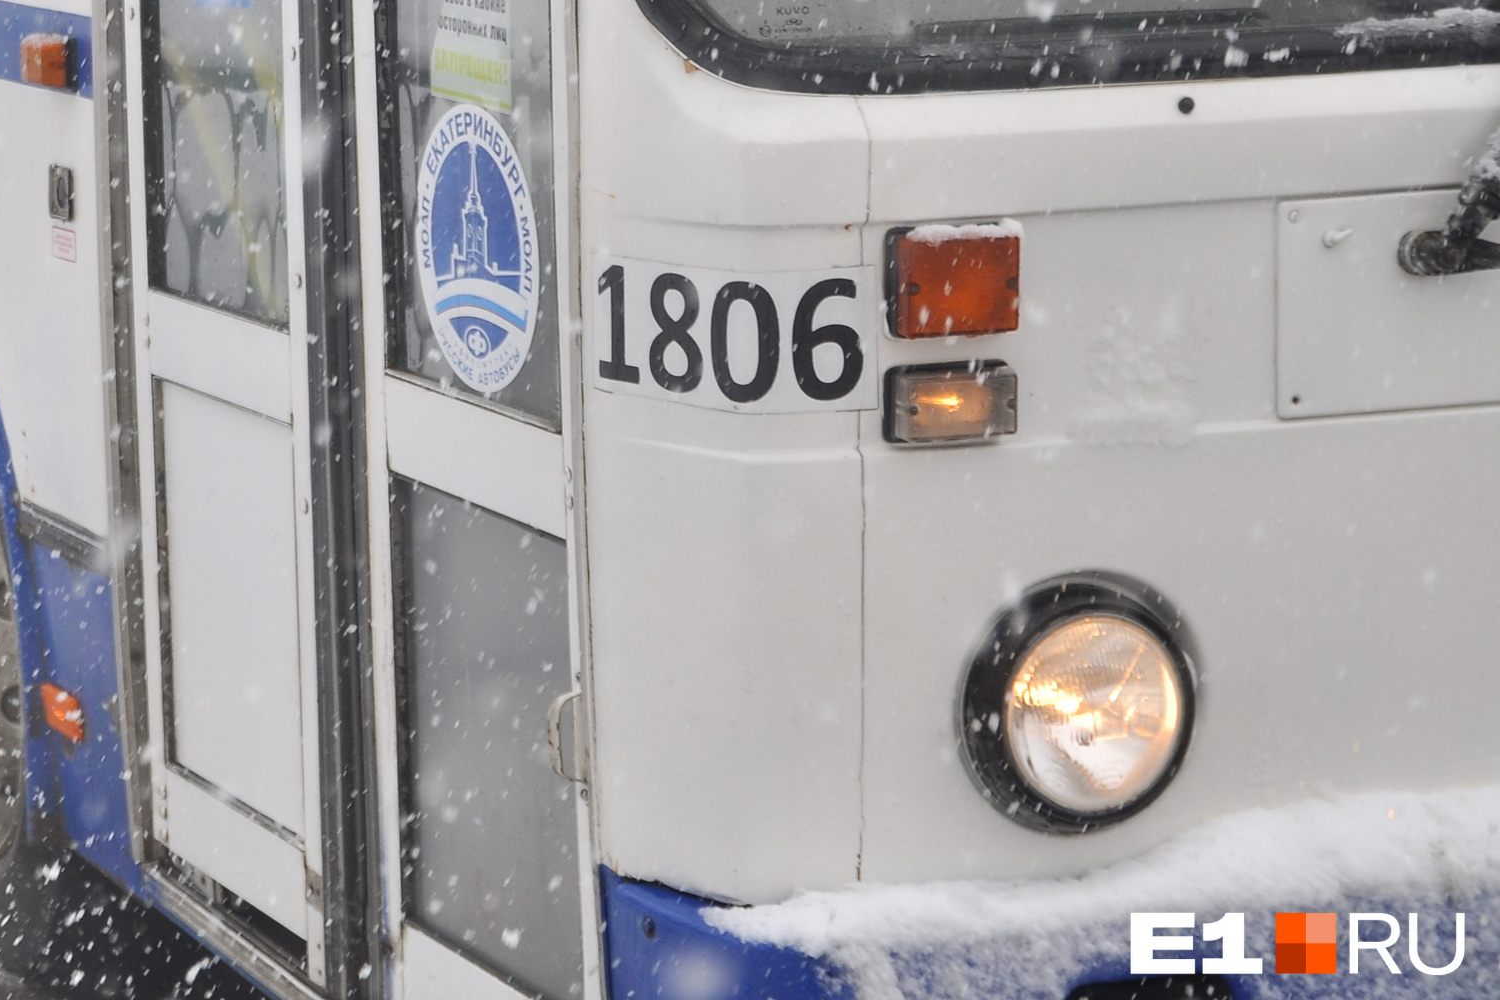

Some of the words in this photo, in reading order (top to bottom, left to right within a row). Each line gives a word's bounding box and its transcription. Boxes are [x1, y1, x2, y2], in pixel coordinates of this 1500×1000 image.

[490, 26, 507, 45] лиц
[422, 197, 431, 268] МОАП
[427, 112, 526, 199] ЕКАТЕРИНБУРГ
[520, 219, 533, 294] МОАП
[479, 348, 520, 385] АВТОБУСЫ
[598, 265, 863, 403] 1806
